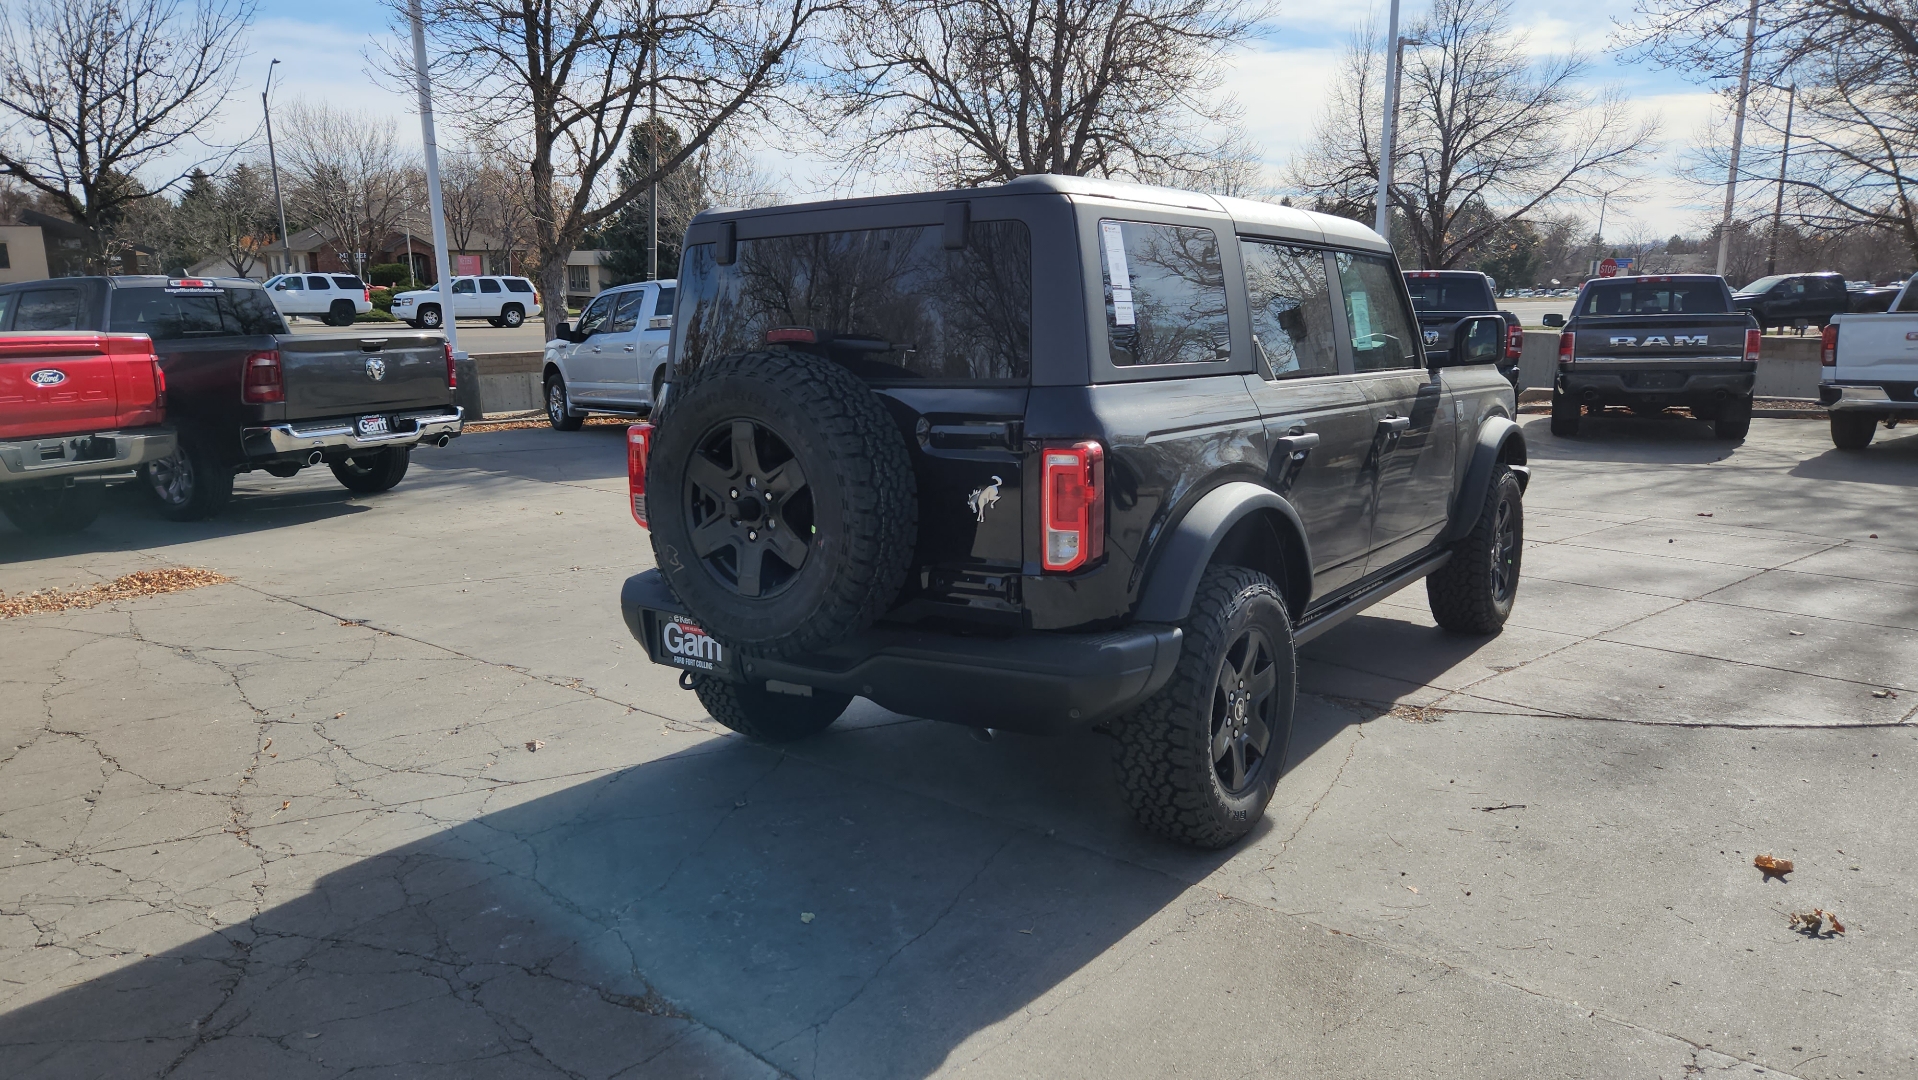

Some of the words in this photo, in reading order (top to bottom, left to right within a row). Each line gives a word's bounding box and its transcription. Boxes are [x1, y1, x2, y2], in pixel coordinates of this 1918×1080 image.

[1600, 264, 1617, 274] STOP
[1609, 335, 1709, 348] RAM
[36, 371, 60, 383] Ford
[358, 417, 388, 433] Garff
[696, 660, 713, 670] COLLINS
